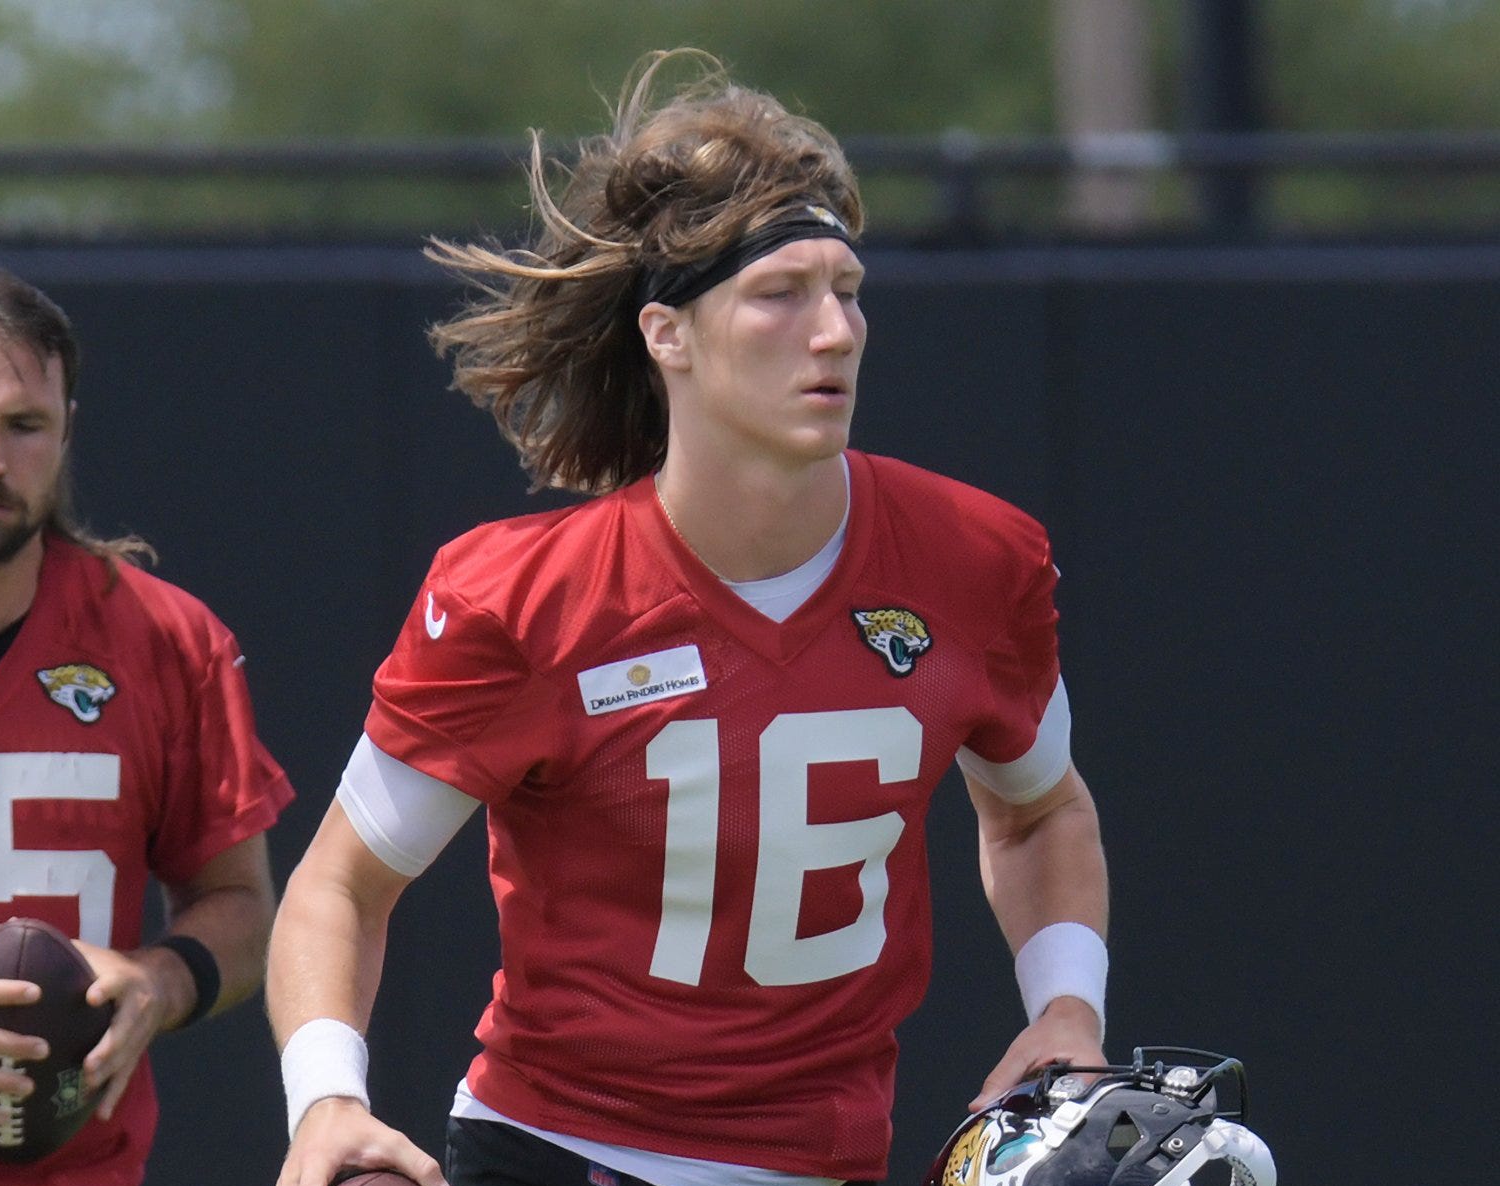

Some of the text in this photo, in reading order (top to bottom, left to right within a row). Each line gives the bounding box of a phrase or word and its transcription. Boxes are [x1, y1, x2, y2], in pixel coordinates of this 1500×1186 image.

[590, 675, 701, 711] DREAM FINDERS HOMES
[645, 706, 924, 987] 16
